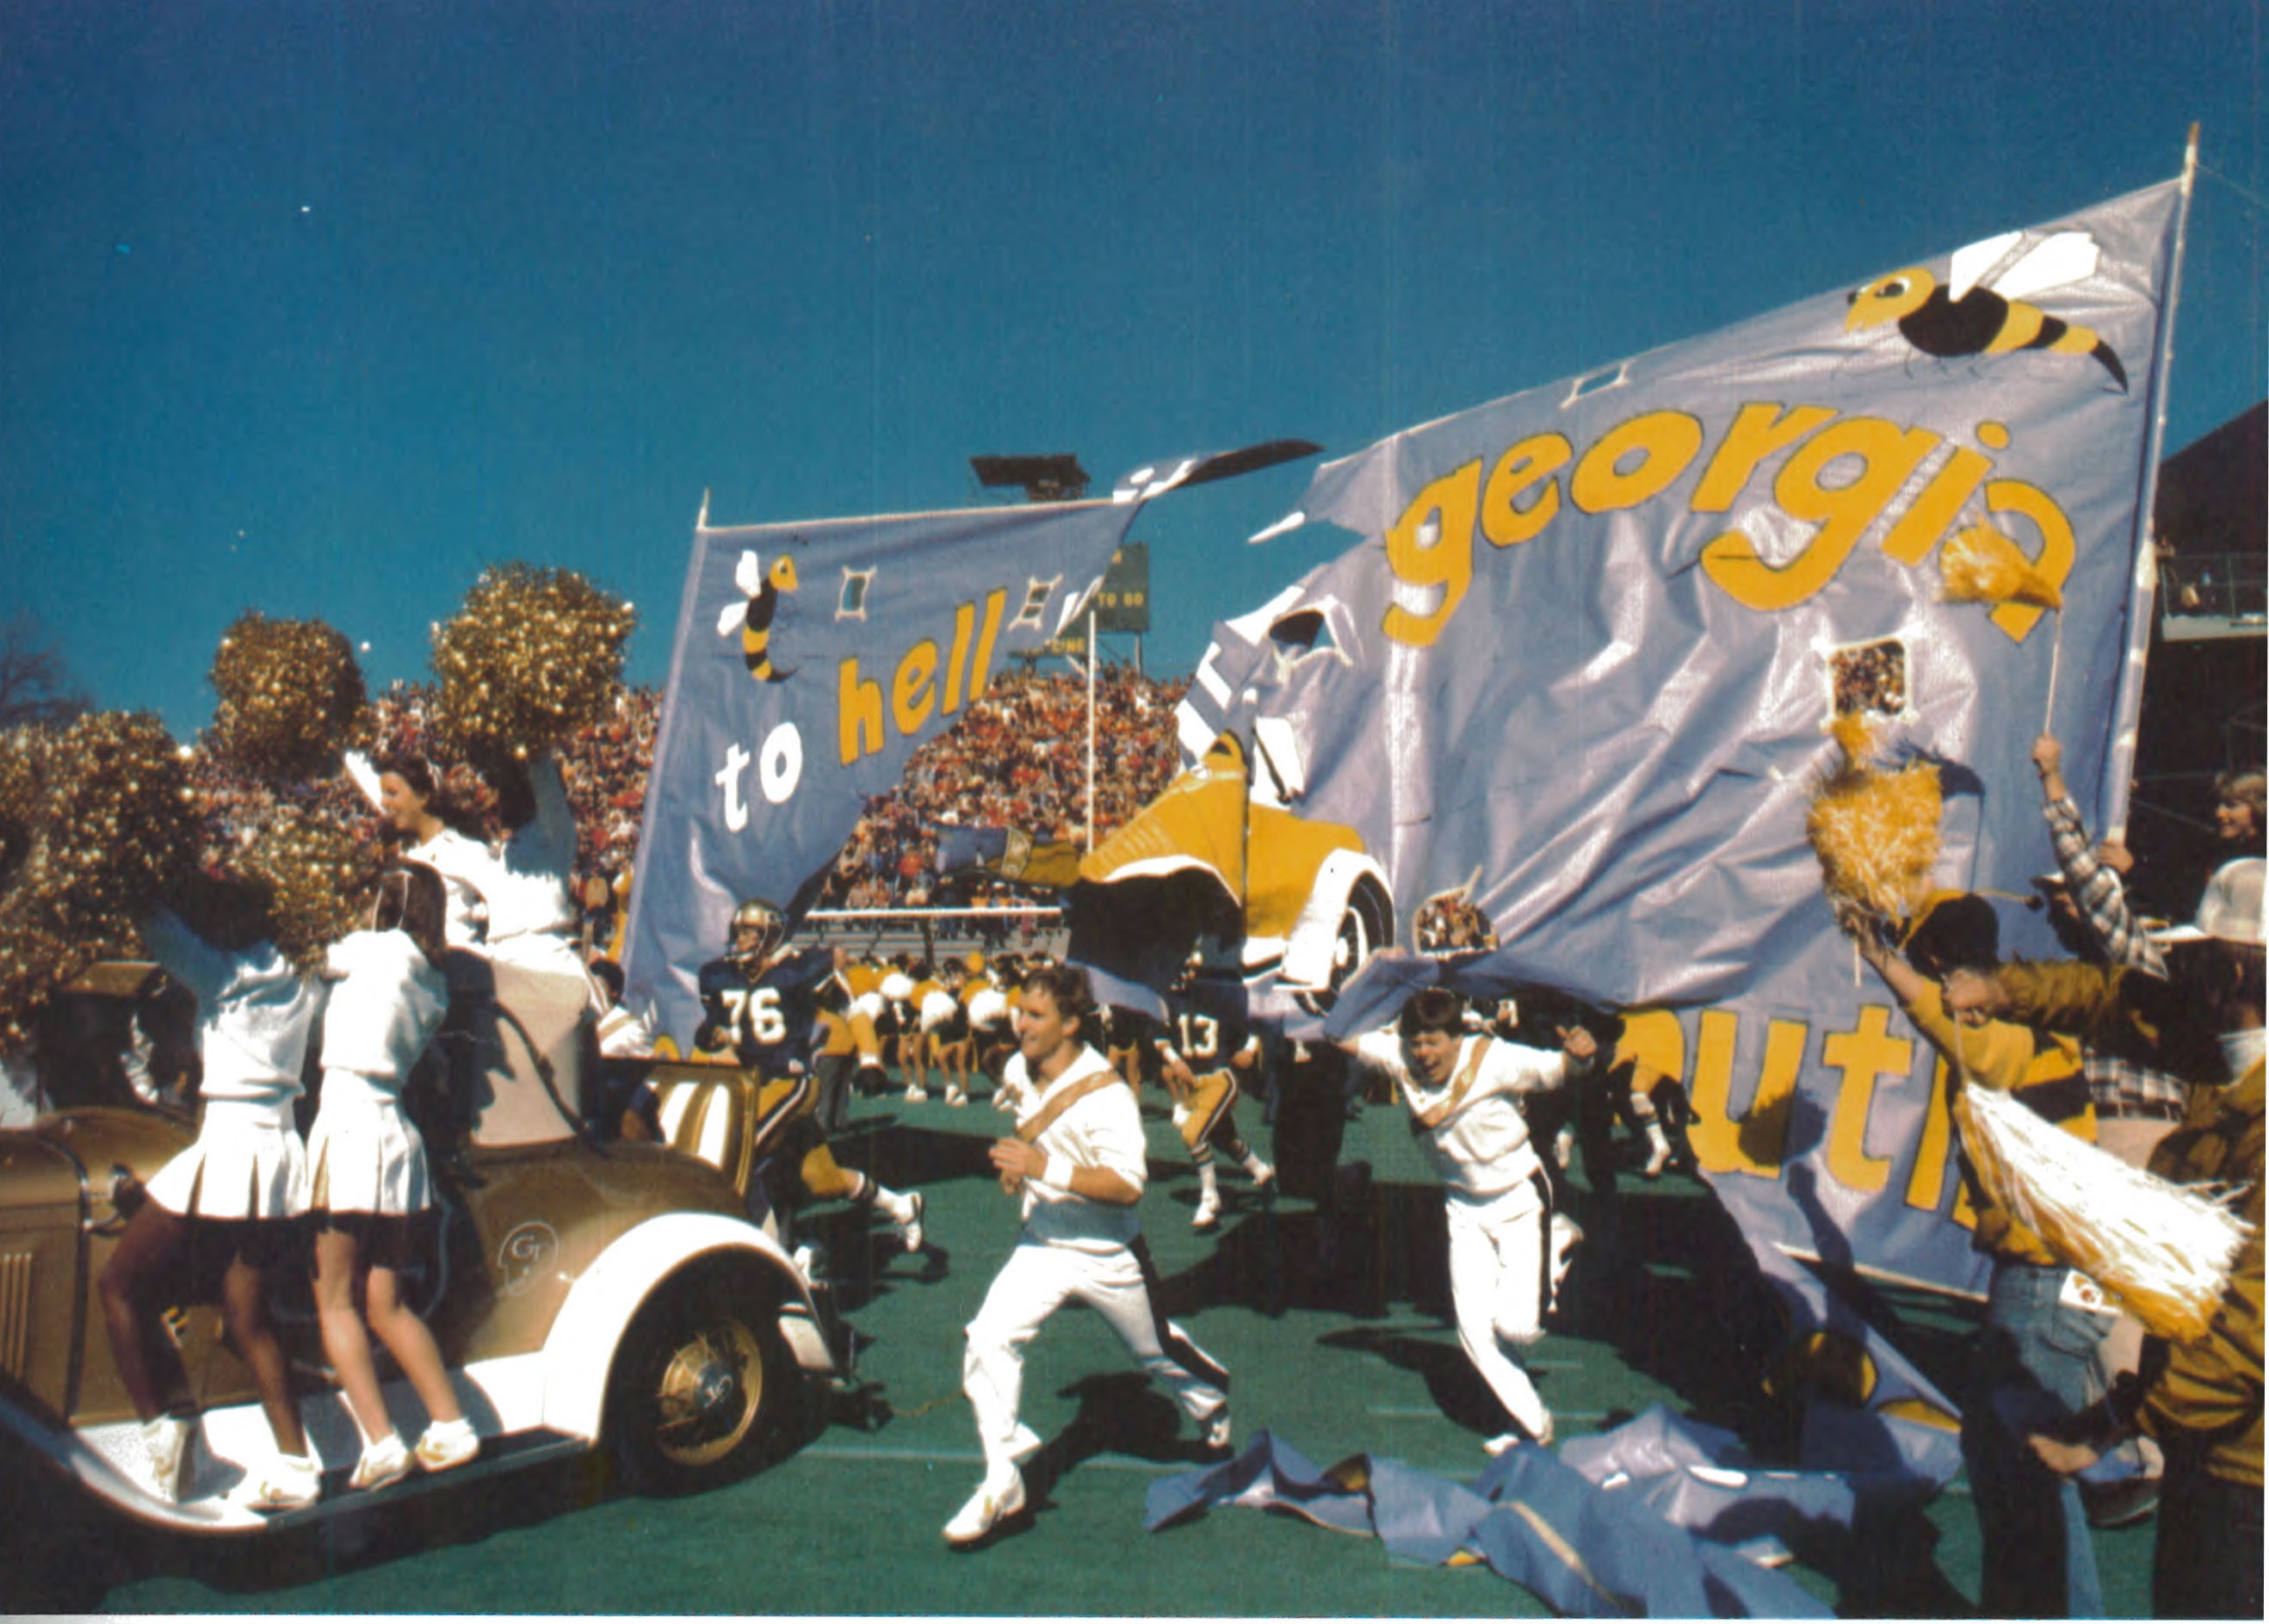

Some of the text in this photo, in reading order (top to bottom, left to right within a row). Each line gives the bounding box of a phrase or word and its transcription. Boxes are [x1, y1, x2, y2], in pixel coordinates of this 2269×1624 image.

[1382, 401, 2076, 647] georgia
[715, 721, 803, 833] to
[838, 587, 1007, 766] hell
[721, 986, 787, 1045] 76
[1178, 1013, 1219, 1059] 13
